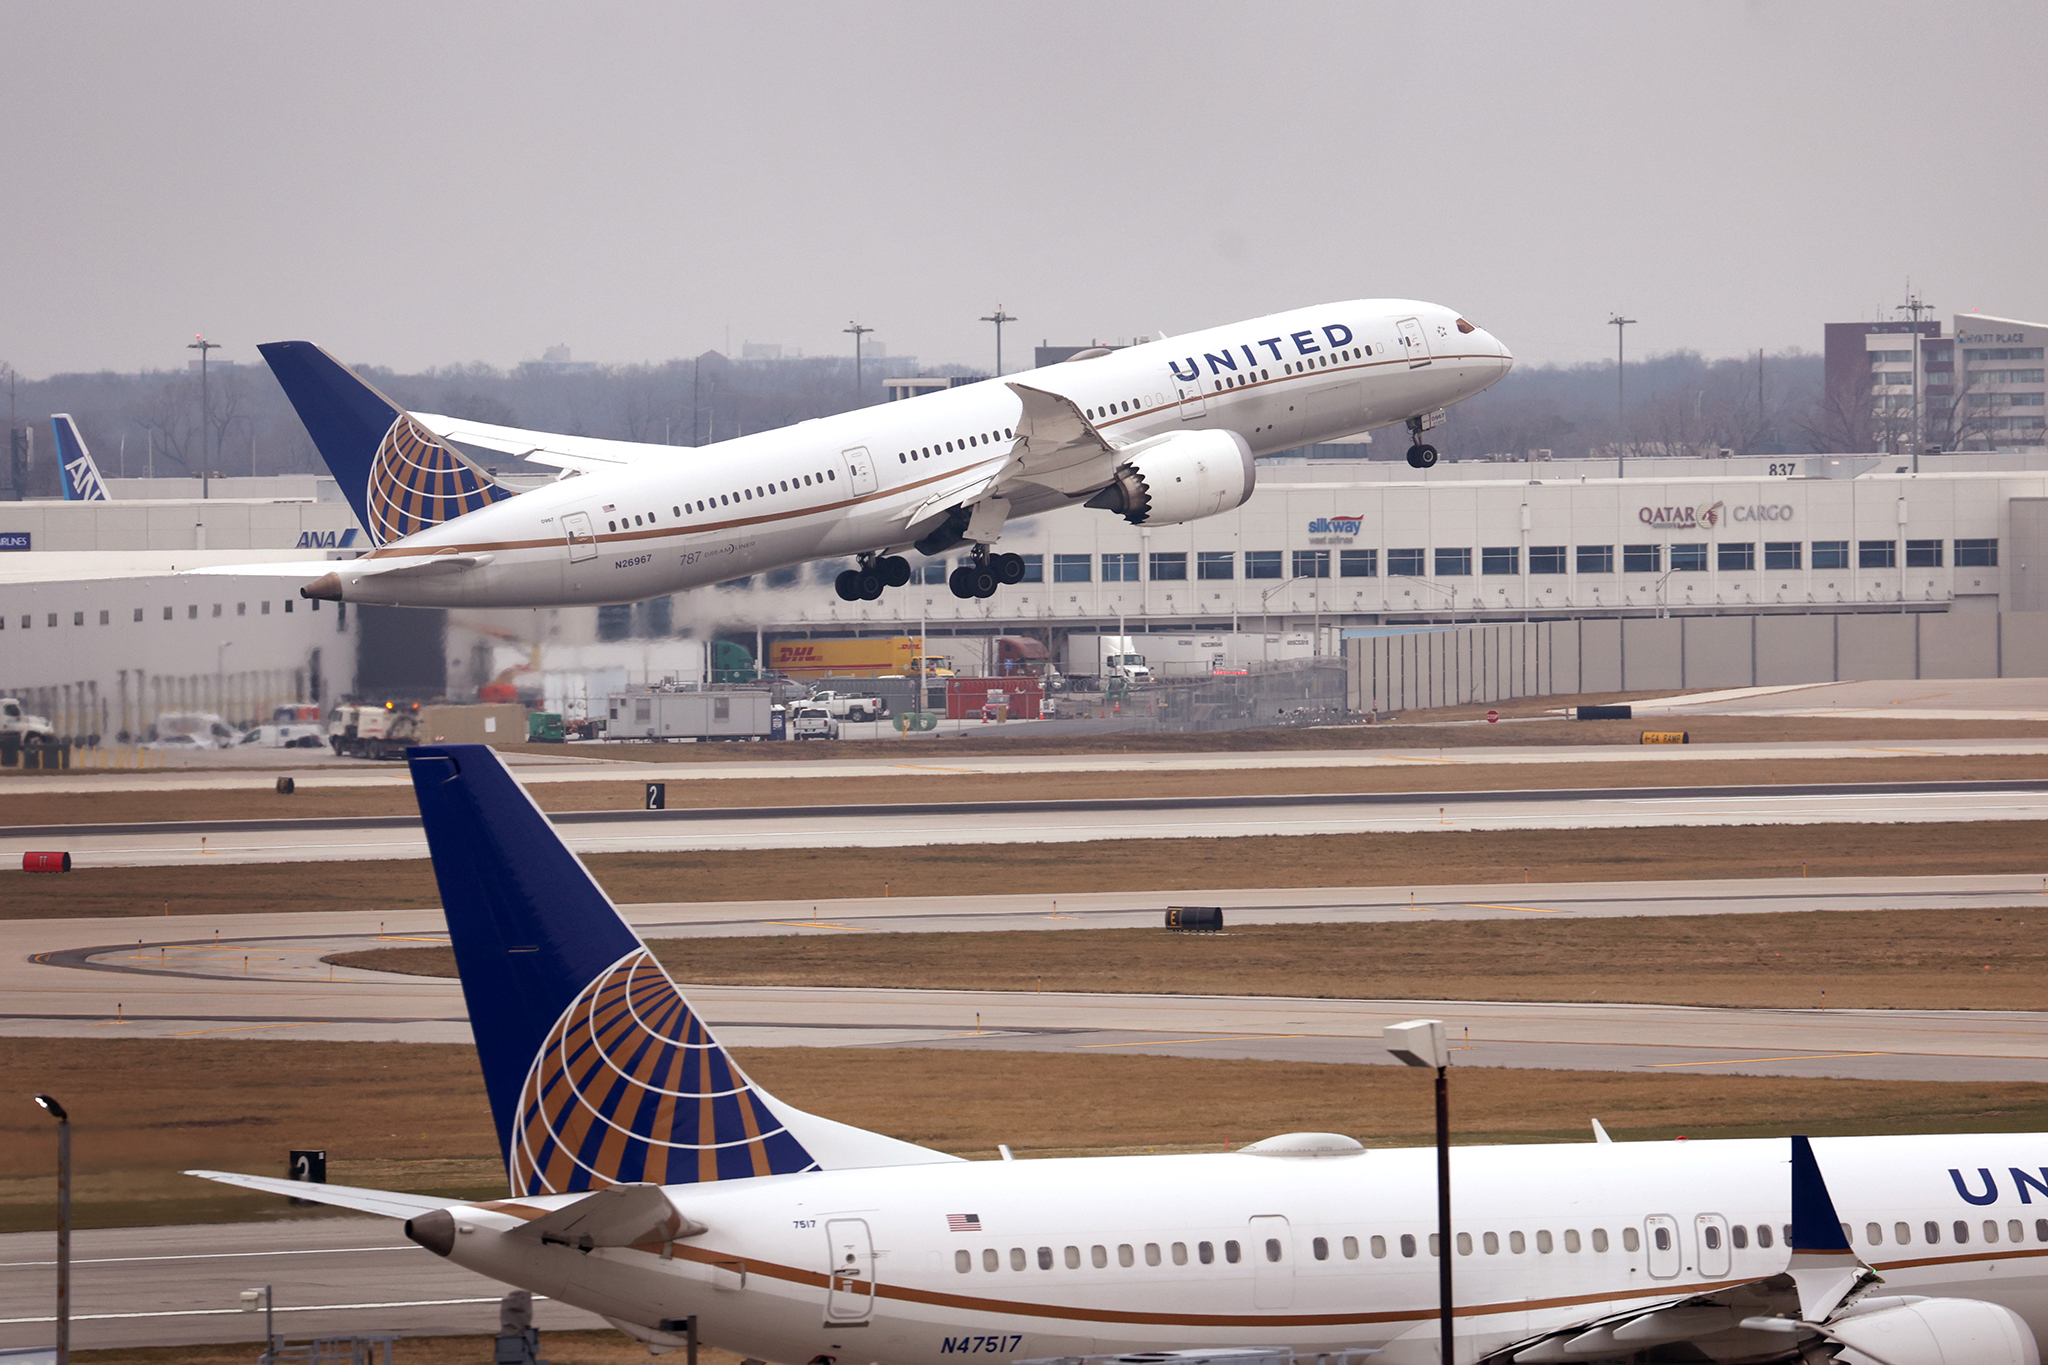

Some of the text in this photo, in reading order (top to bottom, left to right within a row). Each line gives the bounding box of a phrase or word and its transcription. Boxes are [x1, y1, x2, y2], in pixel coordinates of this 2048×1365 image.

[1966, 333, 2024, 344] HYATT PLACE
[1168, 324, 1353, 382] UNITED
[1769, 463, 1796, 476] 837
[1639, 505, 1793, 525] QATAR CARGO
[1308, 517, 1362, 536] silkway
[295, 531, 336, 548] ANA
[615, 554, 652, 569] N26967
[679, 551, 702, 566] 787
[779, 646, 817, 662] DHL
[649, 785, 657, 809] 2
[1170, 910, 1177, 925] E
[1947, 1167, 2048, 1206] UN
[793, 1219, 816, 1229] 7517
[940, 1335, 1023, 1353] N47517
